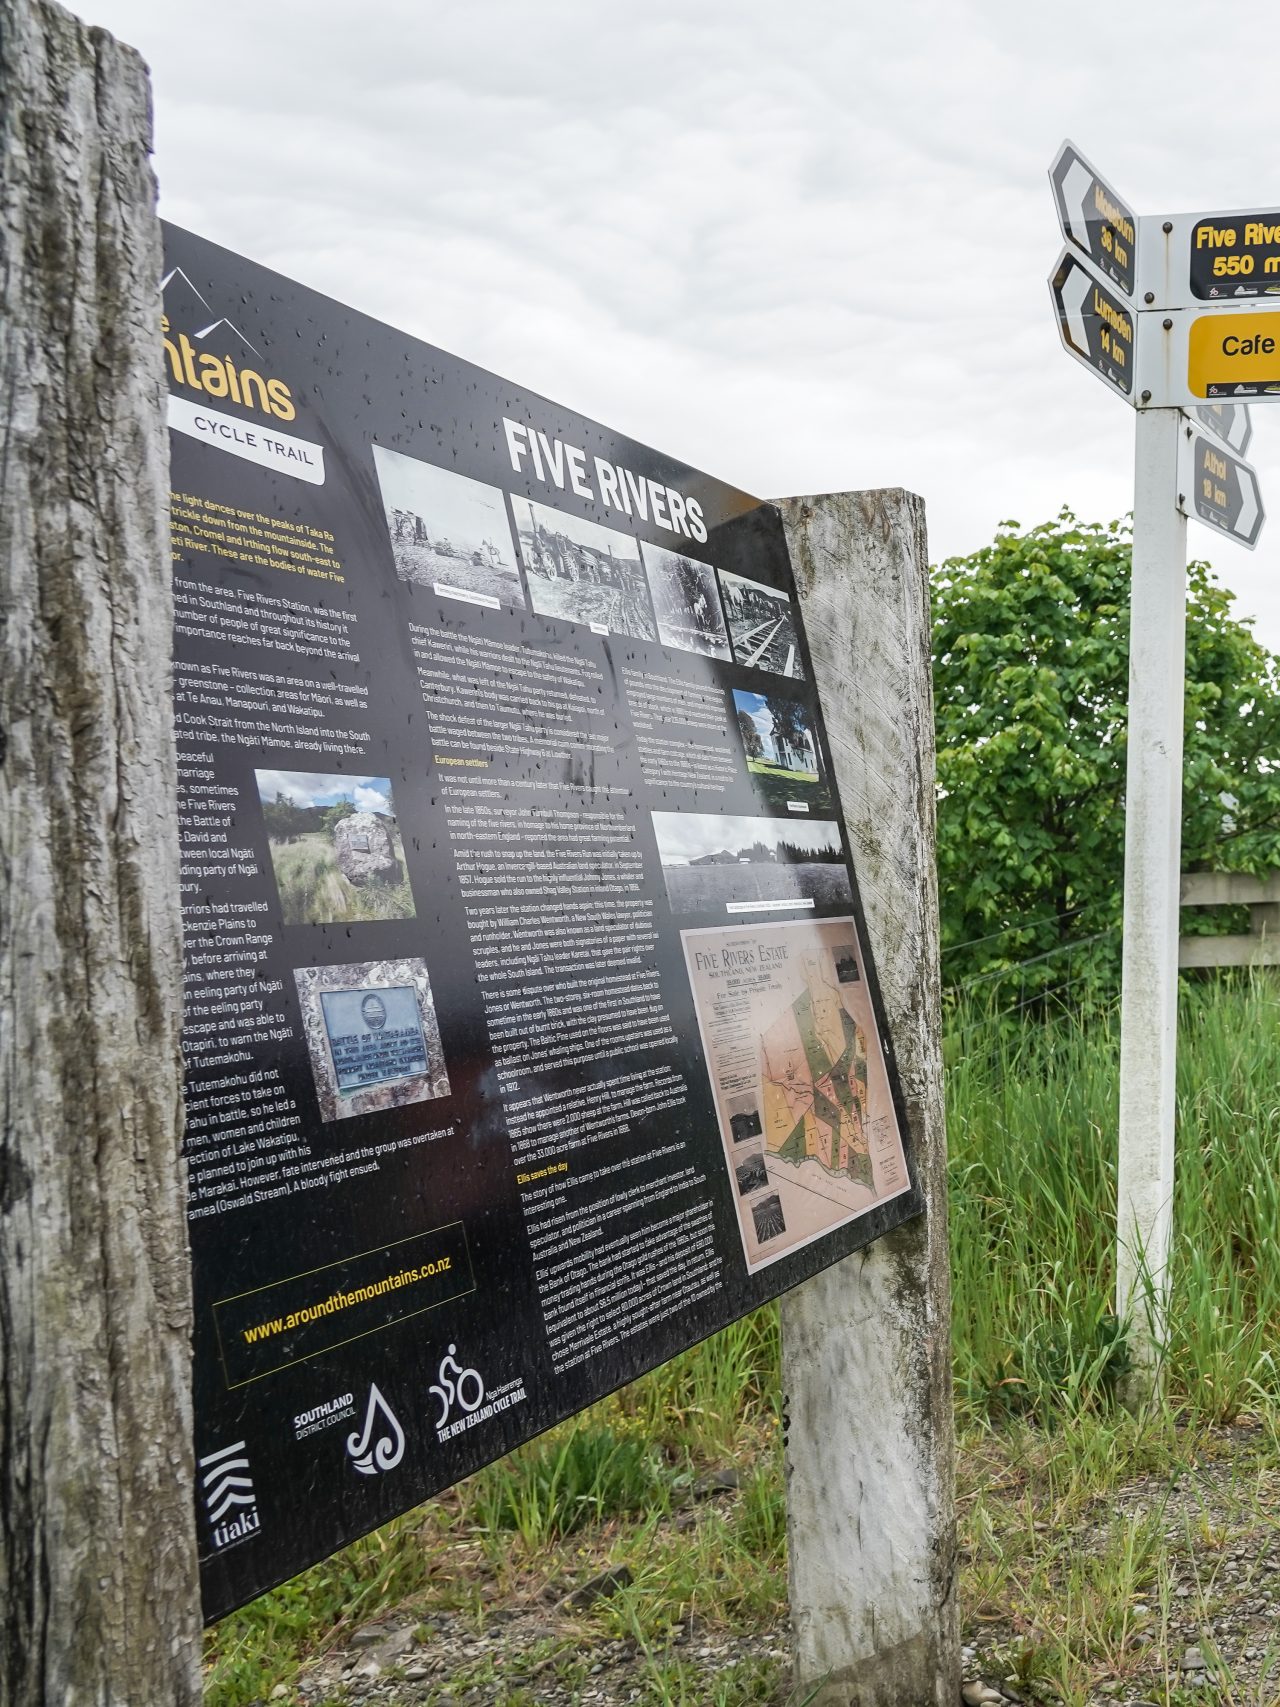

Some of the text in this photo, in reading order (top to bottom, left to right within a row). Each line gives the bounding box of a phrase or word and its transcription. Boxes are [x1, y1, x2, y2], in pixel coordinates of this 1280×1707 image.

[1114, 238, 1128, 269] km
[1196, 226, 1237, 249] Five
[1212, 254, 1255, 277] 550
[1094, 288, 1132, 344] Lumsden
[1101, 328, 1125, 367] 14 km
[1222, 334, 1276, 356] Cafe
[162, 333, 296, 421] ntains
[194, 416, 315, 466] CYCLE TRAIL
[502, 416, 708, 544] FIVE RIVERS
[1203, 448, 1227, 481] Athol
[1214, 484, 1227, 508] km
[171, 505, 334, 554] trickle down from the mountainside. The
[181, 493, 334, 541] light dances over the peaks of Taka Ra
[183, 538, 345, 583] River. These are the bodies of water Five
[192, 525, 225, 542] Cromel
[225, 533, 242, 546] and
[271, 544, 289, 557] flow
[331, 559, 341, 569] to
[174, 577, 197, 591] from
[197, 582, 214, 594] the
[236, 590, 255, 602] Five
[255, 594, 282, 607] Rivers
[312, 607, 329, 616] was
[328, 608, 342, 619] the
[341, 611, 357, 622] first
[200, 665, 212, 674] as
[211, 665, 231, 676] Five
[230, 667, 258, 680] Rivers
[258, 673, 275, 682] was
[275, 676, 286, 684] an
[285, 677, 304, 686] area
[304, 680, 315, 688] on
[320, 680, 368, 695] well-travelled
[175, 691, 186, 702] at
[188, 693, 199, 703] Te
[270, 702, 287, 713] and
[220, 733, 236, 743] the
[293, 739, 323, 753] already
[322, 742, 344, 754] living
[343, 744, 365, 754] there.
[434, 755, 488, 767] European settlers
[192, 815, 231, 825] Battle of
[465, 902, 563, 916] Two years later the station changed
[197, 932, 273, 947] the Crown Range
[695, 944, 789, 971] FIVE RIVERS ESTATE
[217, 1035, 229, 1046] to
[229, 1034, 252, 1044] warn
[252, 1029, 269, 1041] the
[281, 1164, 300, 1178] fate
[300, 1153, 345, 1173] intervened
[344, 1149, 360, 1162] and
[360, 1145, 374, 1158] the
[374, 1142, 397, 1156] group
[397, 1138, 412, 1148] was
[411, 1127, 446, 1144] overtaken
[446, 1125, 454, 1135] at
[292, 1181, 300, 1192] A
[300, 1173, 329, 1192] bloody
[328, 1168, 349, 1184] fight
[348, 1160, 380, 1177] ensued.
[516, 1160, 568, 1184] Ellis saves the day
[521, 1191, 532, 1202] The
[532, 1186, 548, 1200] story
[554, 1180, 566, 1191] how
[566, 1176, 578, 1187] Ellis
[578, 1173, 593, 1183] came
[531, 1226, 602, 1261] Australia and New Zealand.
[538, 1282, 549, 1293] the
[548, 1275, 563, 1289] Bank
[570, 1265, 588, 1281] Otago.
[244, 1256, 452, 1344] www.aroundthemountains.co.nz
[294, 1392, 354, 1429] SOUTHLAND
[295, 1406, 356, 1440] DISTRICT COUNCIL
[437, 1387, 527, 1443] THE NEW ZEALAND CYCLE TRAIL
[214, 1505, 261, 1547] tiaki
